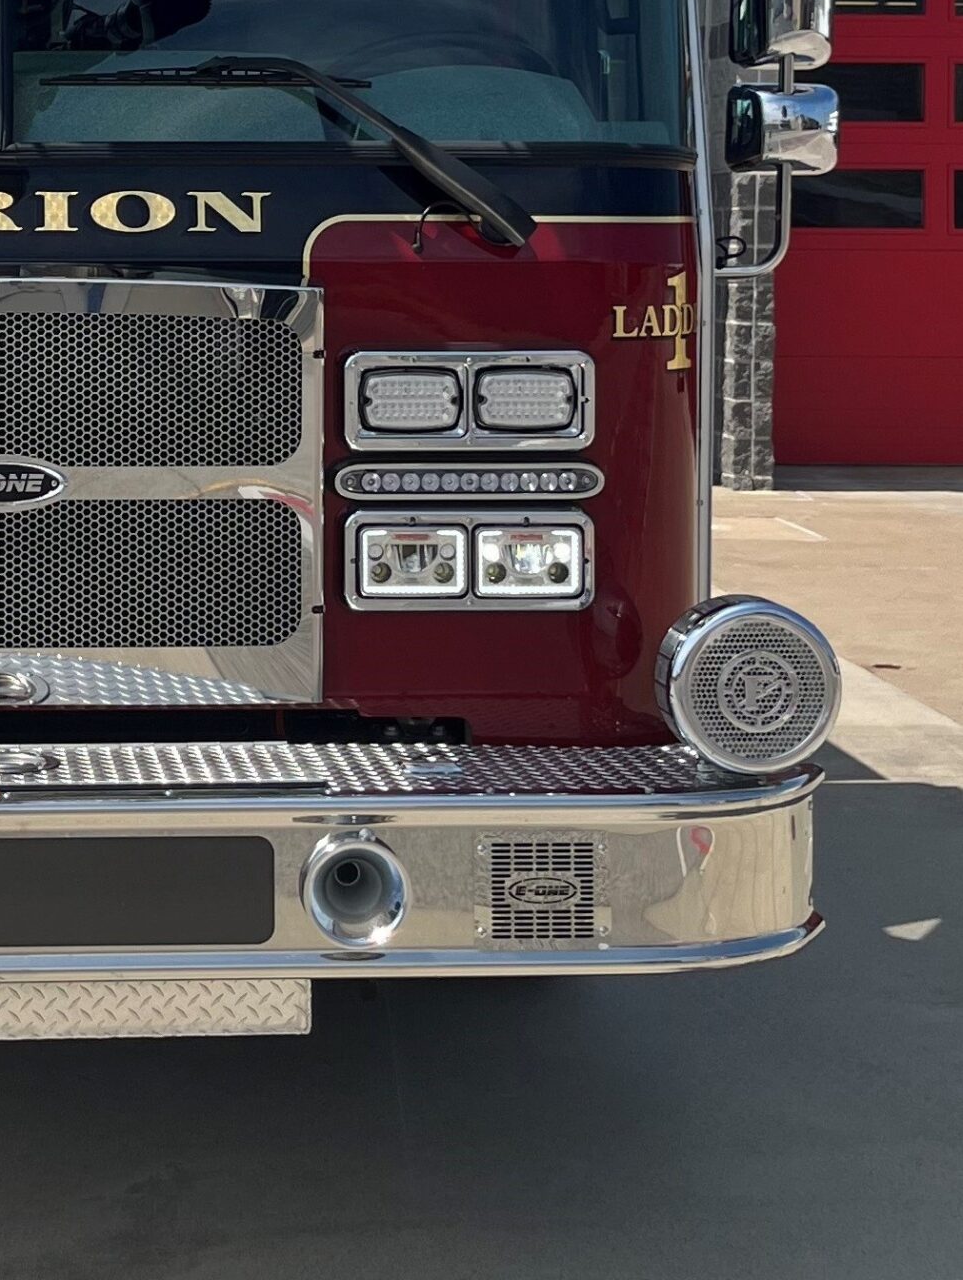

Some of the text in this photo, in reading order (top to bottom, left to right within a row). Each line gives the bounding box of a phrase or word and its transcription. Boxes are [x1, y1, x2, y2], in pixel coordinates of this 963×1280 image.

[612, 303, 697, 339] LADD
[666, 271, 692, 371] 1
[515, 885, 571, 897] E-ONE
